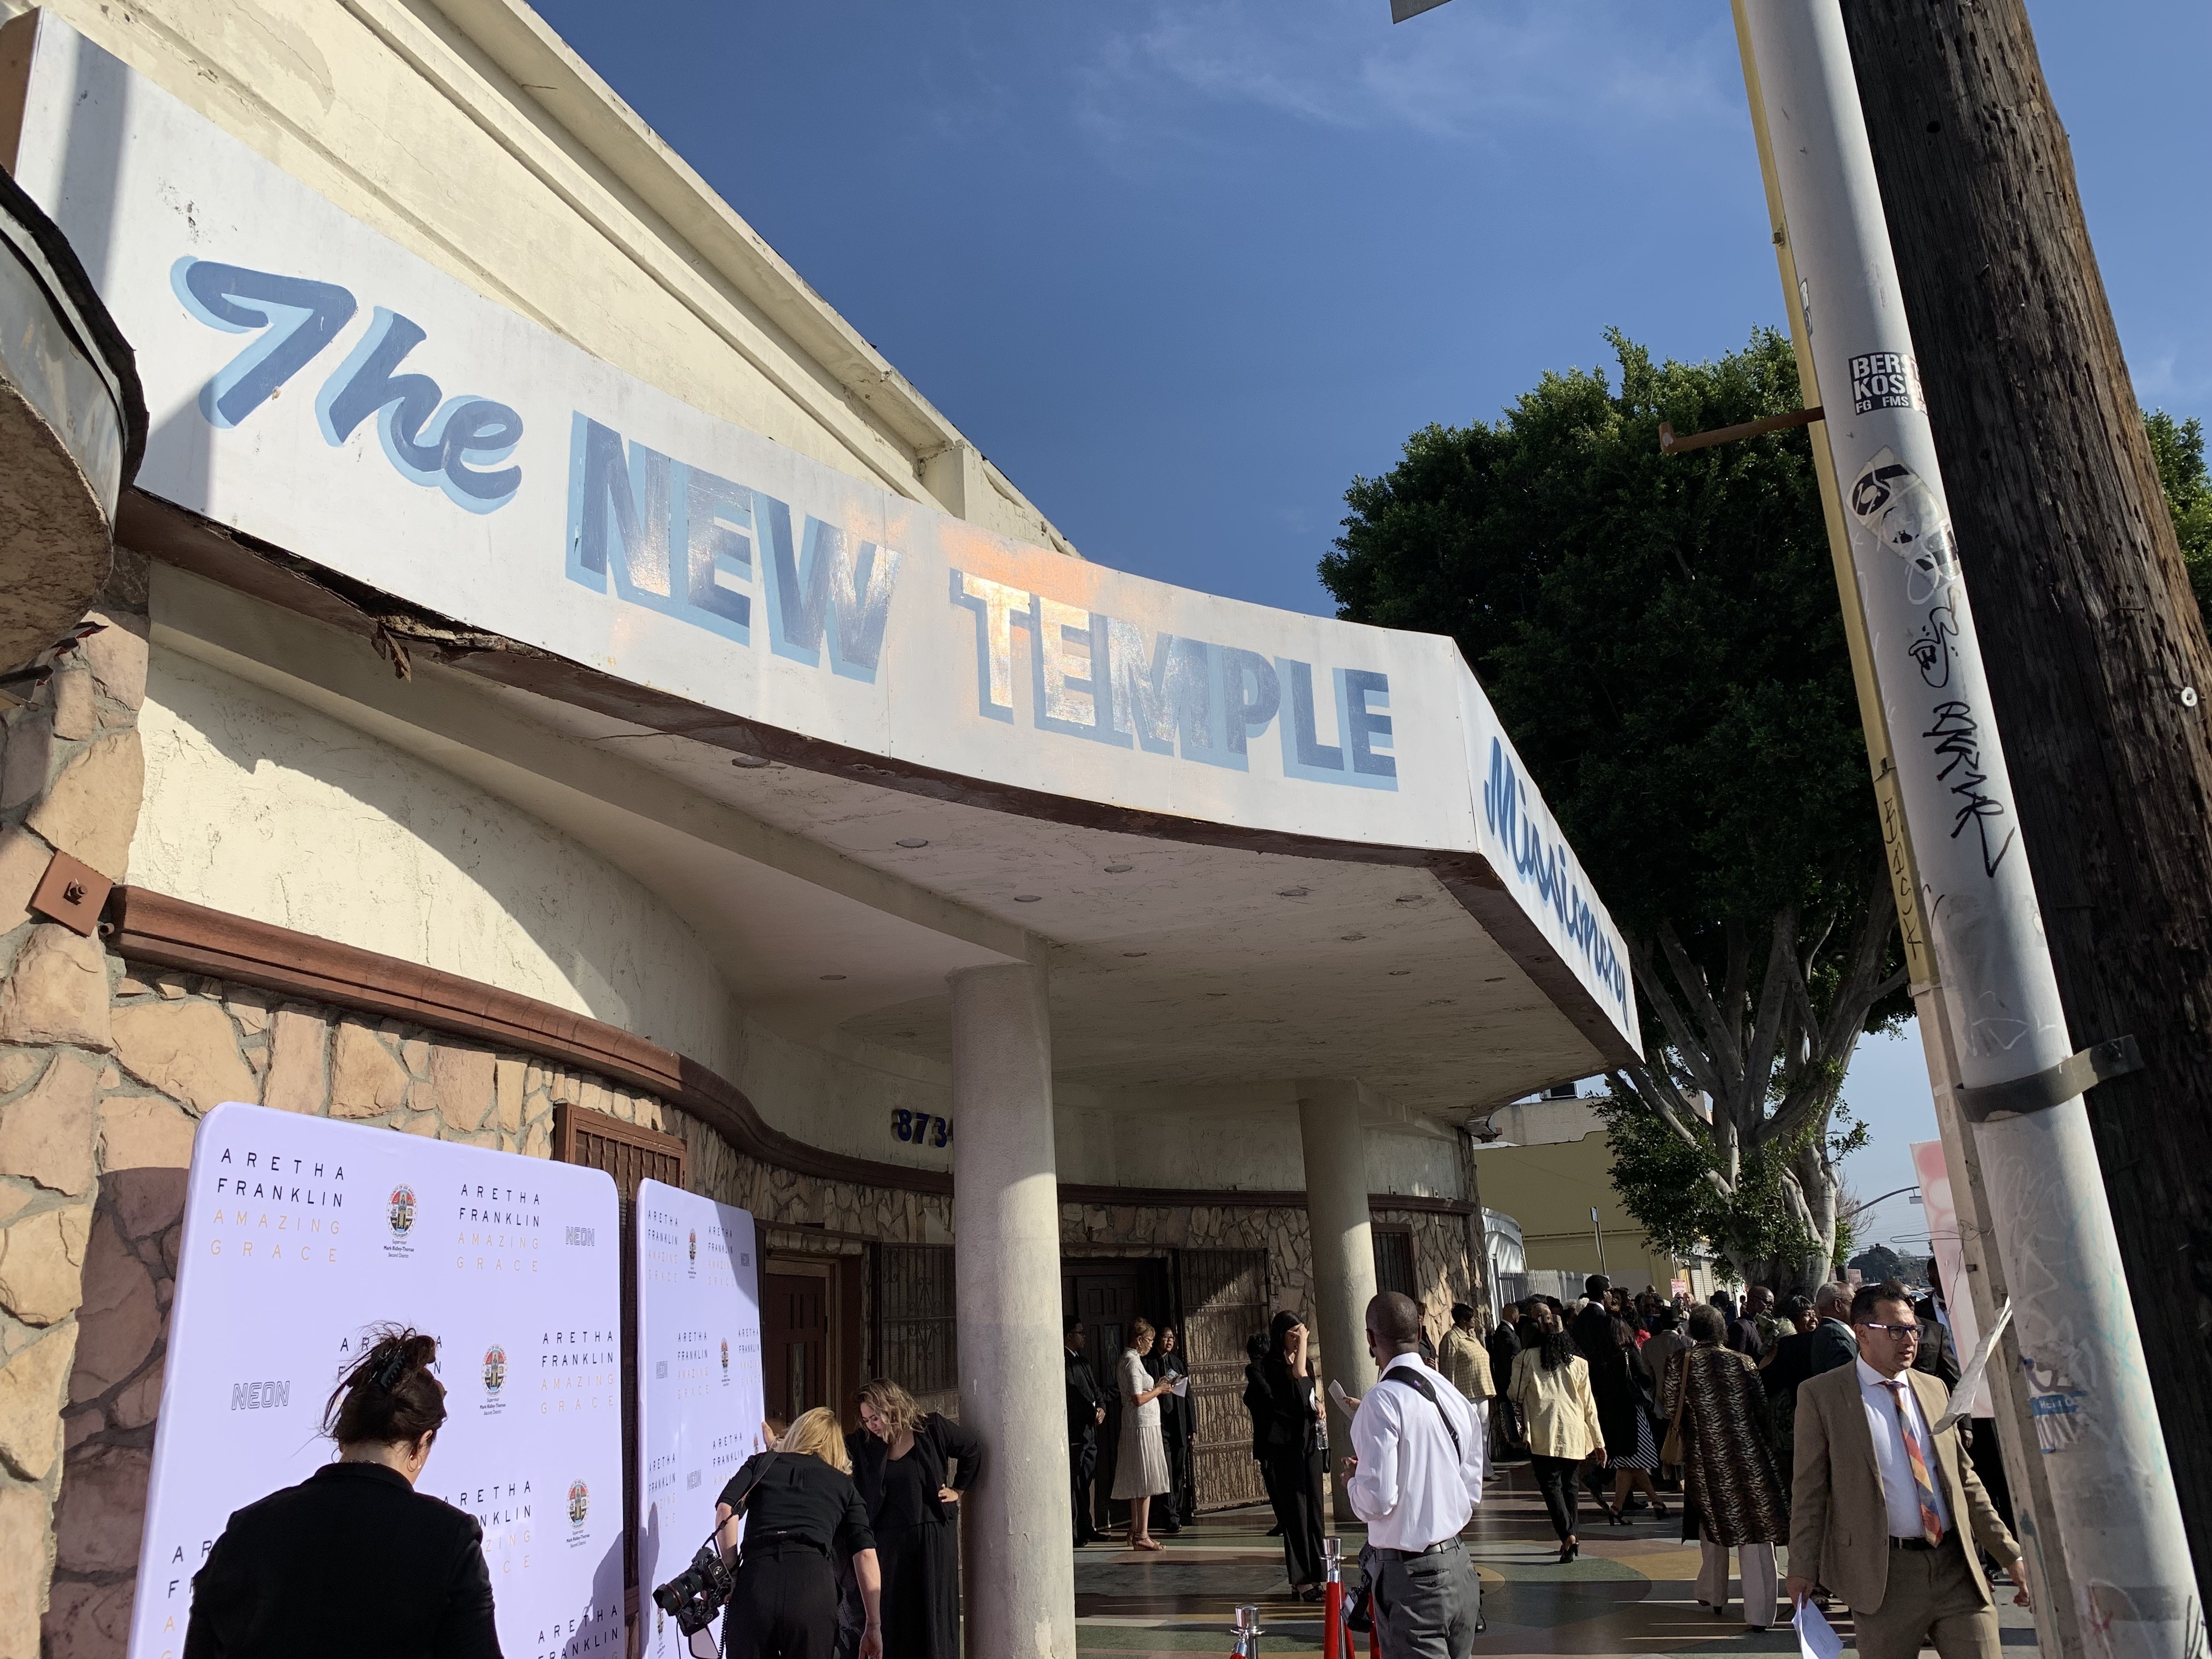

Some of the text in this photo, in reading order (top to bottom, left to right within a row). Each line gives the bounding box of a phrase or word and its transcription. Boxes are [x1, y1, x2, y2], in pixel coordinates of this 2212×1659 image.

[1856, 396, 1909, 413] FG FMS
[170, 255, 1398, 793] The NEW TEMPLE
[891, 1109, 953, 1148] 873
[221, 1148, 344, 1180] ARETHA
[218, 1178, 343, 1208] FRANKLIN
[461, 1184, 540, 1206] ARETHA
[214, 1209, 340, 1235] AMAZING
[460, 1208, 539, 1228] FRANKLIN
[648, 1209, 678, 1228] ARETHA
[458, 1232, 539, 1249] AMAZING
[565, 1226, 595, 1247] NEON
[648, 1229, 677, 1245] FRANKLIN
[709, 1226, 732, 1238] ARETHA
[211, 1240, 337, 1262] GRACE
[708, 1242, 733, 1254] FRANKLIN
[457, 1256, 537, 1272] GRACE
[542, 1331, 613, 1344] ARETHA
[678, 1331, 707, 1342] ARETHA
[738, 1328, 758, 1337] ARETHA
[542, 1352, 613, 1367] FRANKLIN
[678, 1349, 708, 1361] FRANKLIN
[541, 1374, 613, 1391] AMAZING
[231, 1381, 290, 1410] NEON
[541, 1395, 613, 1414] GRACE
[713, 1432, 742, 1450] ARETHA
[649, 1453, 675, 1473] ARETHA
[713, 1449, 743, 1467] FRANKLIN
[649, 1472, 675, 1495] FRANKLIN
[480, 1505, 530, 1527] NKLIN
[485, 1530, 530, 1552] ZING
[538, 1605, 617, 1644] ARETHA
